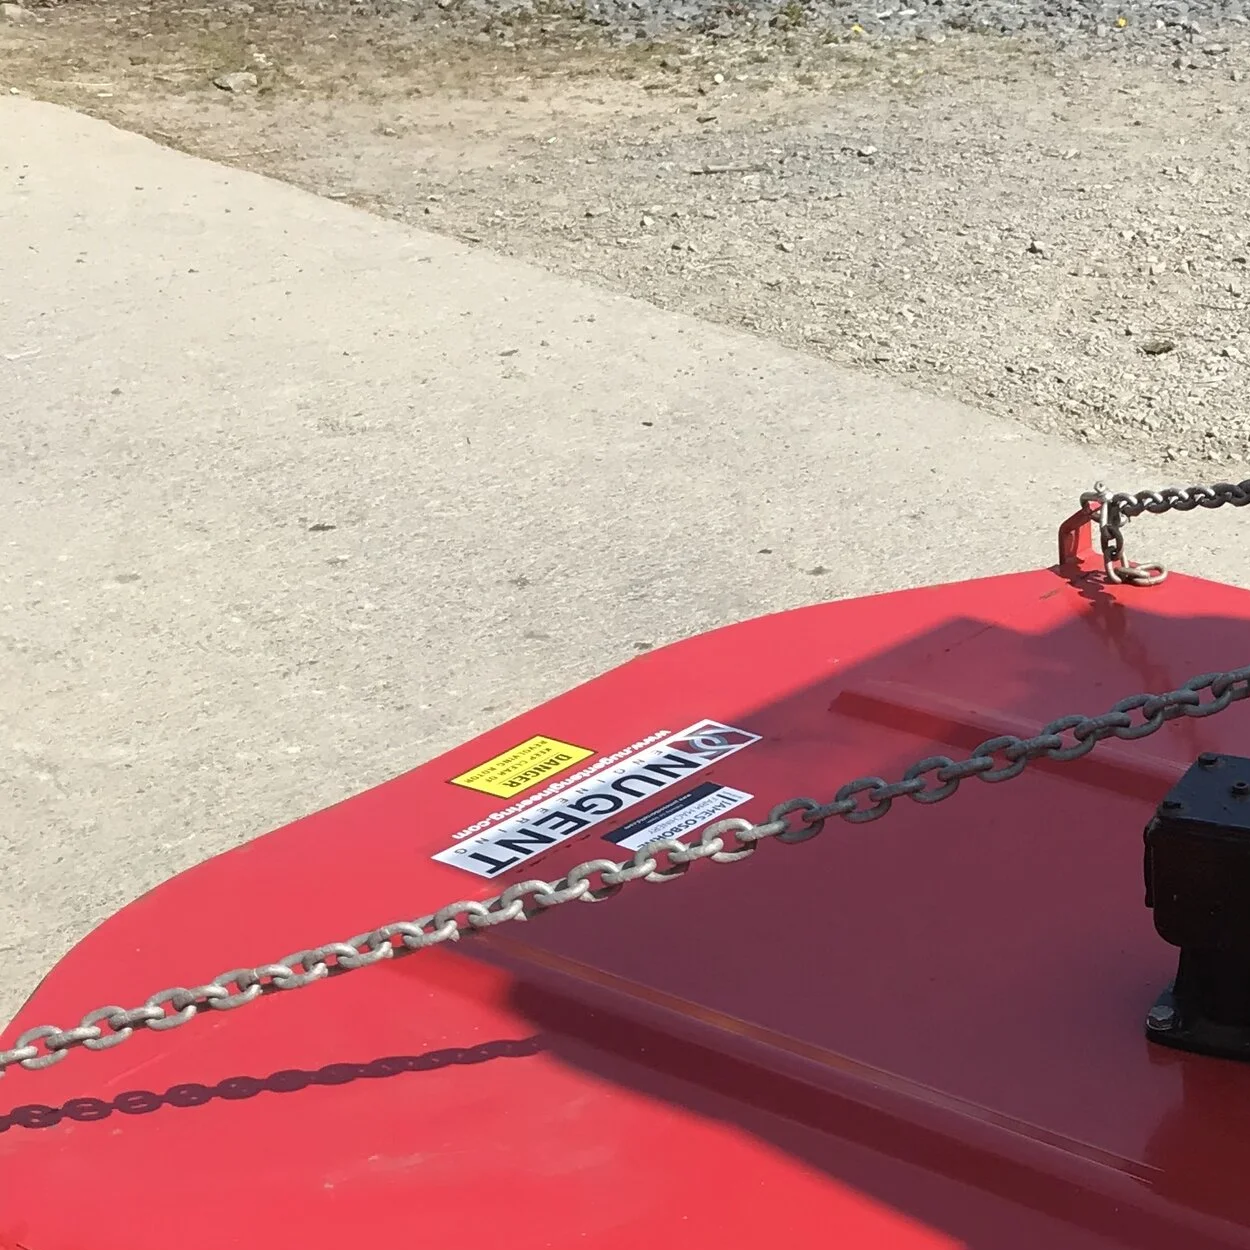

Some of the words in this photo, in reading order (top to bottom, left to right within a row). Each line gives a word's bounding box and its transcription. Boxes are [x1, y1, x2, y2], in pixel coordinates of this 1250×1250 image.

[496, 740, 548, 767] REVOLVING
[530, 748, 552, 760] KEEP
[464, 767, 497, 783] ROTOR
[485, 775, 498, 783] OF
[499, 760, 528, 776] CLEAR
[503, 753, 573, 788] DANGER
[451, 729, 672, 840] www.nugentengineering.com
[454, 750, 662, 855] ENGINEERING
[468, 754, 702, 874] NUGENT
[698, 800, 732, 820] JAMES
